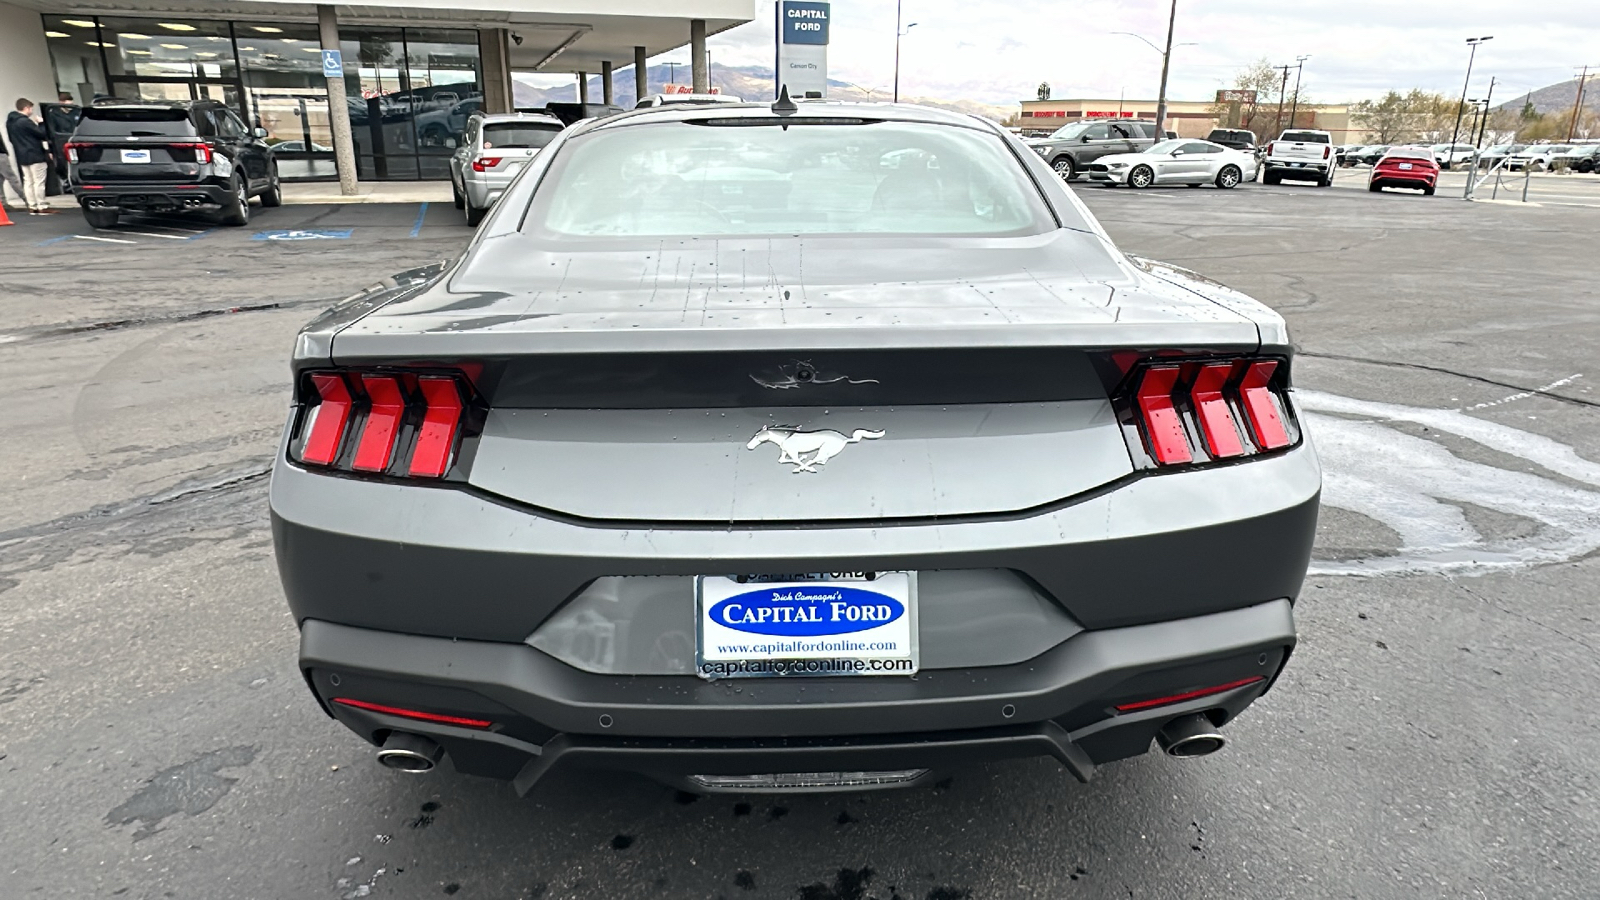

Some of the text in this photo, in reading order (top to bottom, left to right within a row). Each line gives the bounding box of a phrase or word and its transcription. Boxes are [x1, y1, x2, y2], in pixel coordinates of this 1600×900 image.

[787, 9, 827, 19] CAPITAL
[794, 22, 821, 31] FORD
[771, 590, 842, 603] Dick Campagni's
[722, 602, 891, 624] CAPITAL FORD
[717, 640, 897, 655] www.capitalfordonline.com
[701, 658, 913, 676] capitalfordonline.com
